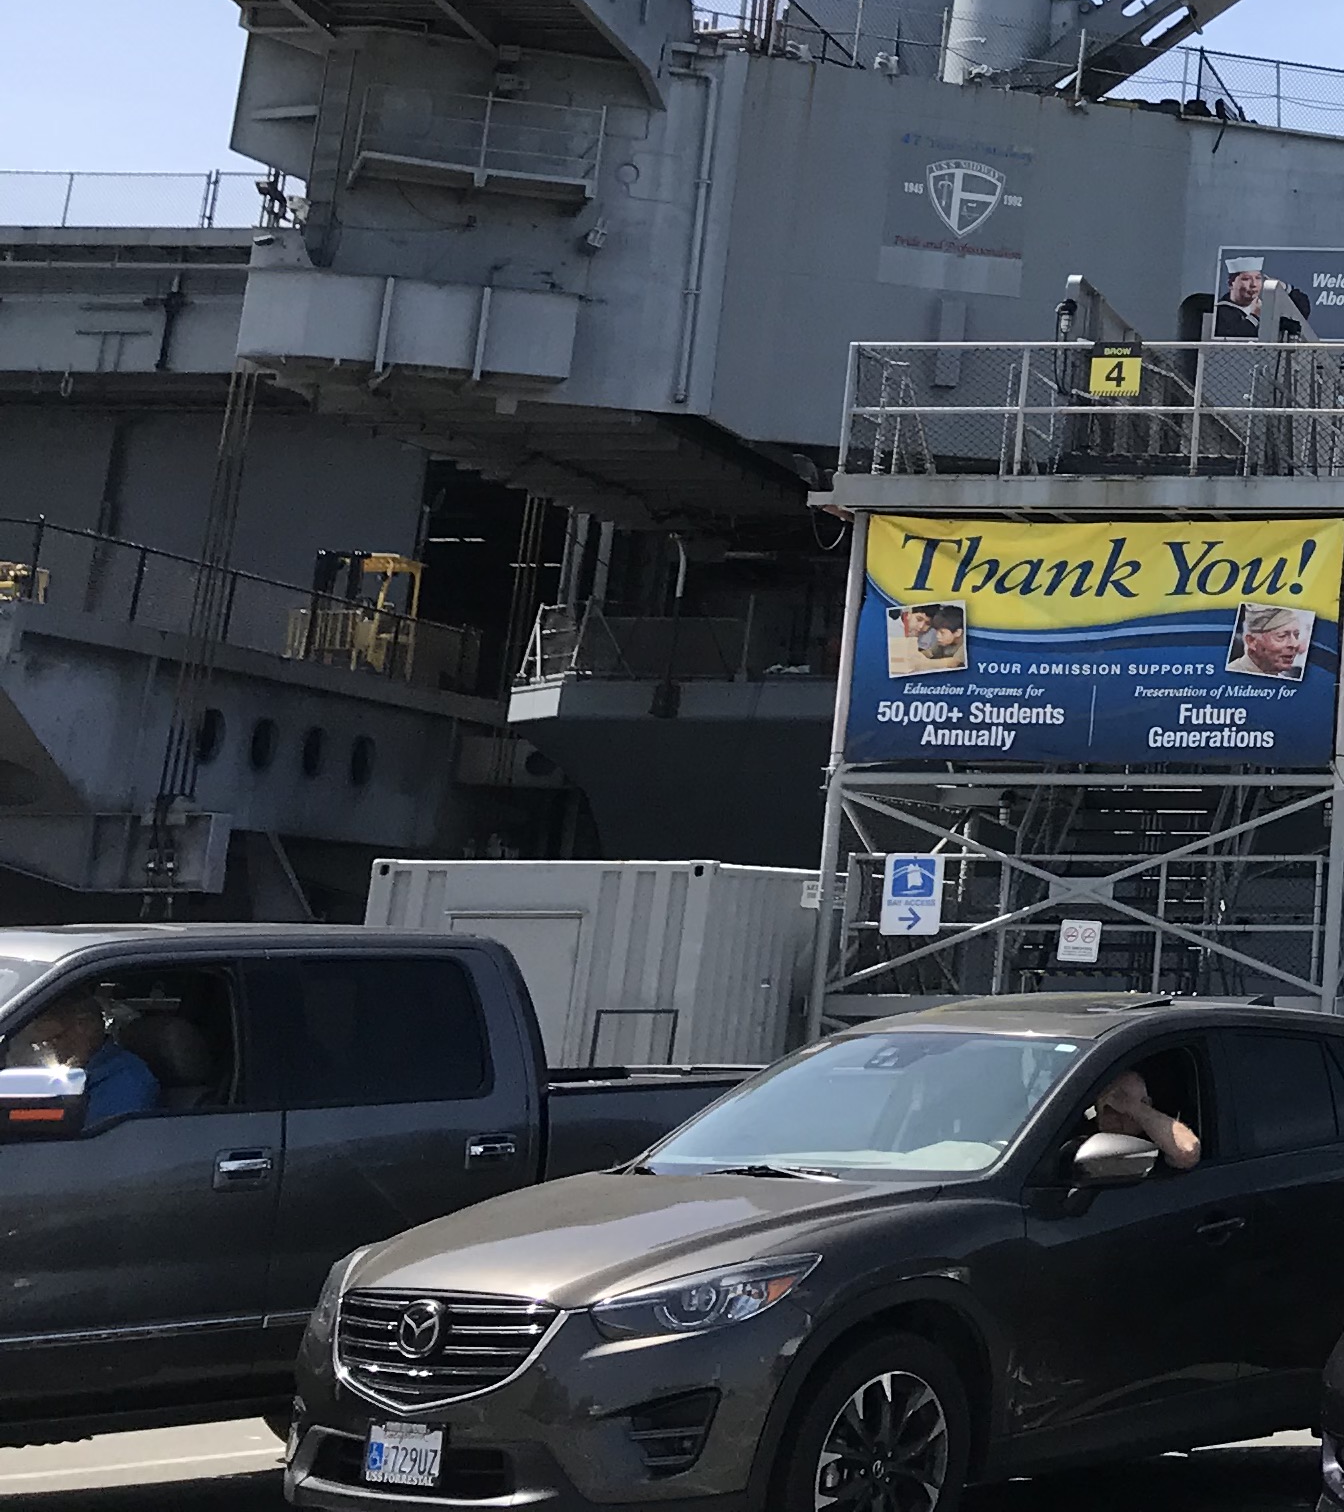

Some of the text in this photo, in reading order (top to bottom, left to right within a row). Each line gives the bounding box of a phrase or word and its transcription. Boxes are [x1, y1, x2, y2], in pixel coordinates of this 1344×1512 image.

[904, 182, 924, 195] 1945
[1104, 347, 1132, 356] BROW
[1104, 360, 1126, 388] 4
[901, 533, 1316, 598] Thank You!
[977, 662, 1216, 677] YOUR ADMISSION SUPPORTS
[902, 682, 1046, 699] Education Programs for
[1134, 685, 1297, 701] Preservation of Midway for
[877, 701, 1065, 728] 50,000+ Students
[1178, 703, 1247, 726] Future
[920, 724, 1016, 751] Annually
[1147, 726, 1275, 749] Generations
[366, 1471, 382, 1483] USS
